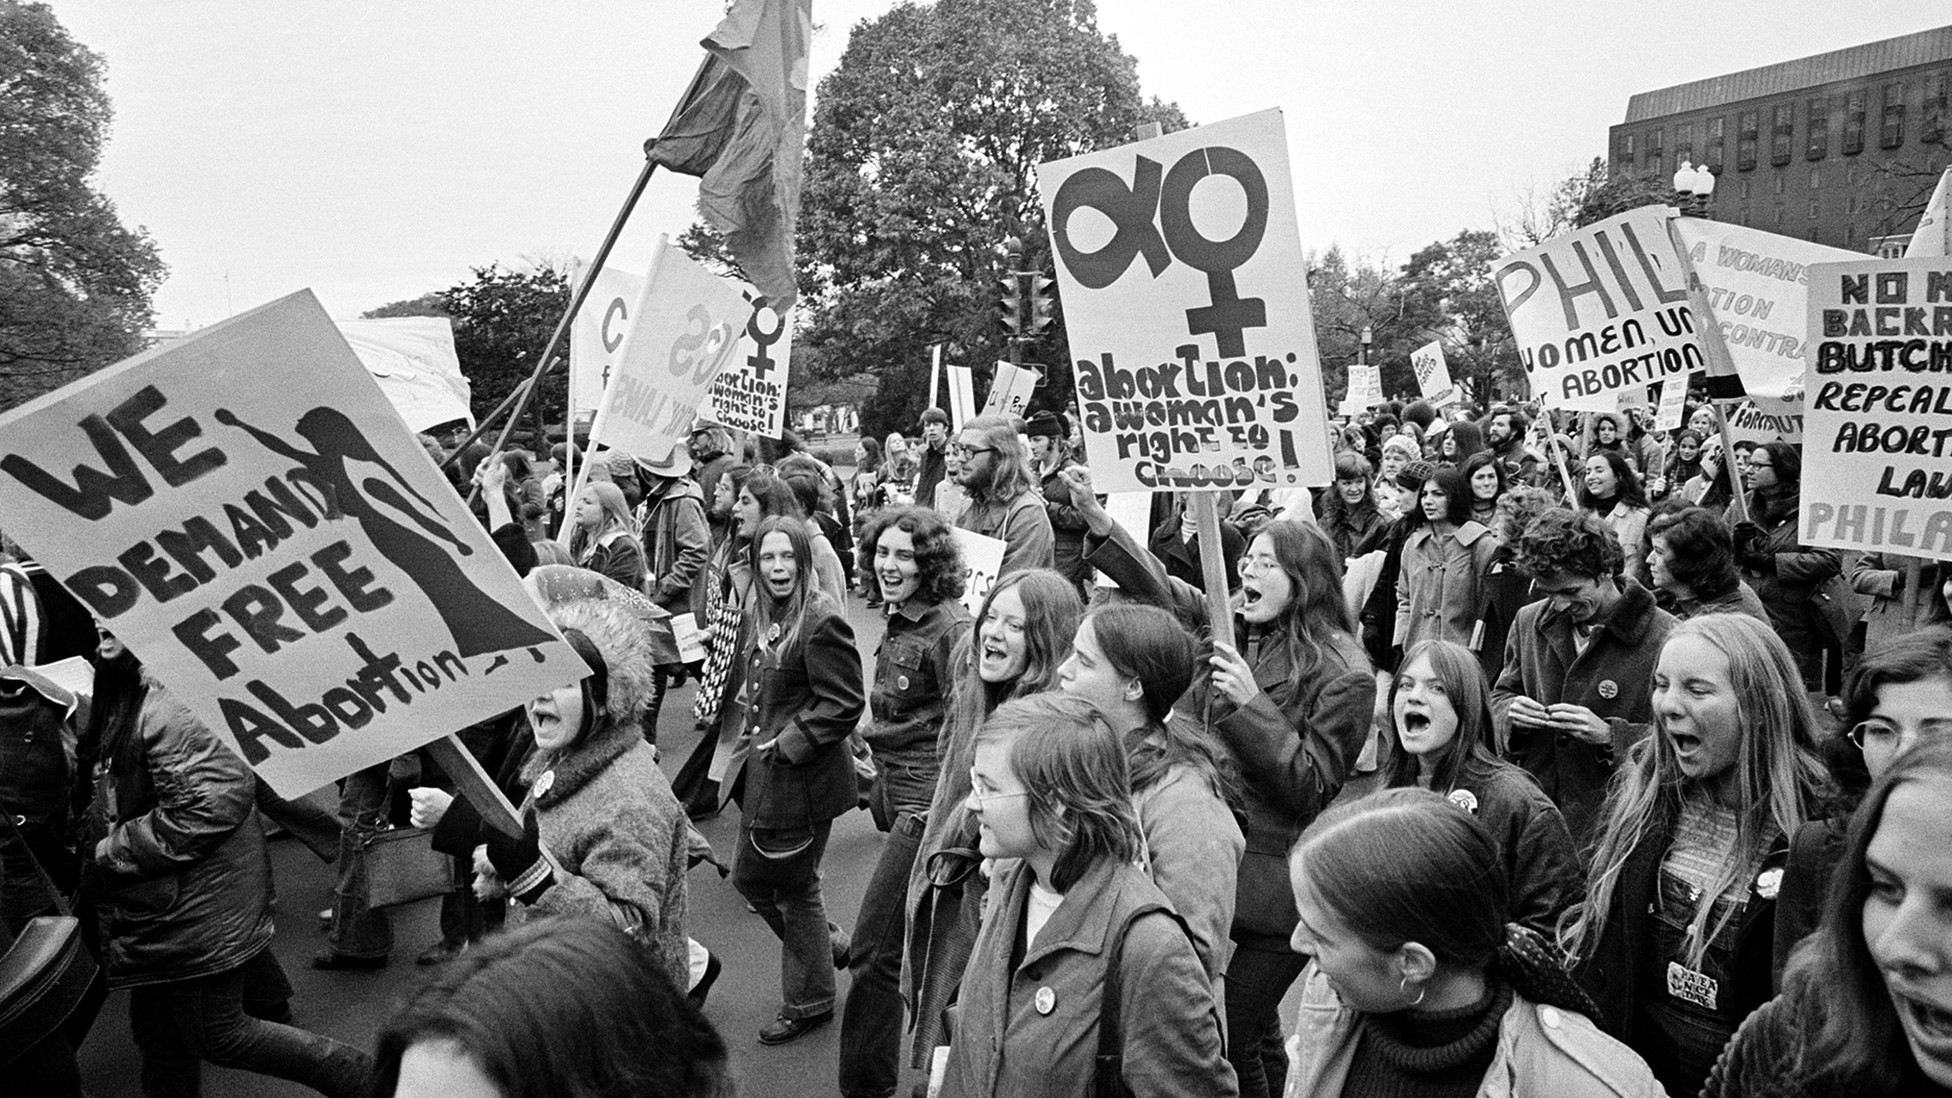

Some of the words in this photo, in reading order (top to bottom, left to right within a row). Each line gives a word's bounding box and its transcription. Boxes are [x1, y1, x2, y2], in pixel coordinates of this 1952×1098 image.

[1495, 222, 1688, 331] PHIL
[1841, 271, 1908, 305] NO
[1926, 271, 1952, 303] M
[1823, 306, 1952, 337] BACKR
[1076, 344, 1299, 402] abortion:
[1562, 343, 1705, 400] ABORTION
[1816, 339, 1952, 375] BUTCH
[712, 396, 748, 415] right
[1085, 401, 1113, 433] a
[1112, 390, 1300, 432] woman's
[1813, 381, 1952, 415] REPEAL
[1, 384, 228, 521] WE
[1116, 426, 1221, 464] right
[1227, 423, 1270, 450] to
[63, 468, 342, 619] DEMAND
[1806, 502, 1952, 553] PHILA
[171, 540, 395, 682] FREE
[217, 632, 468, 767] Abortion
